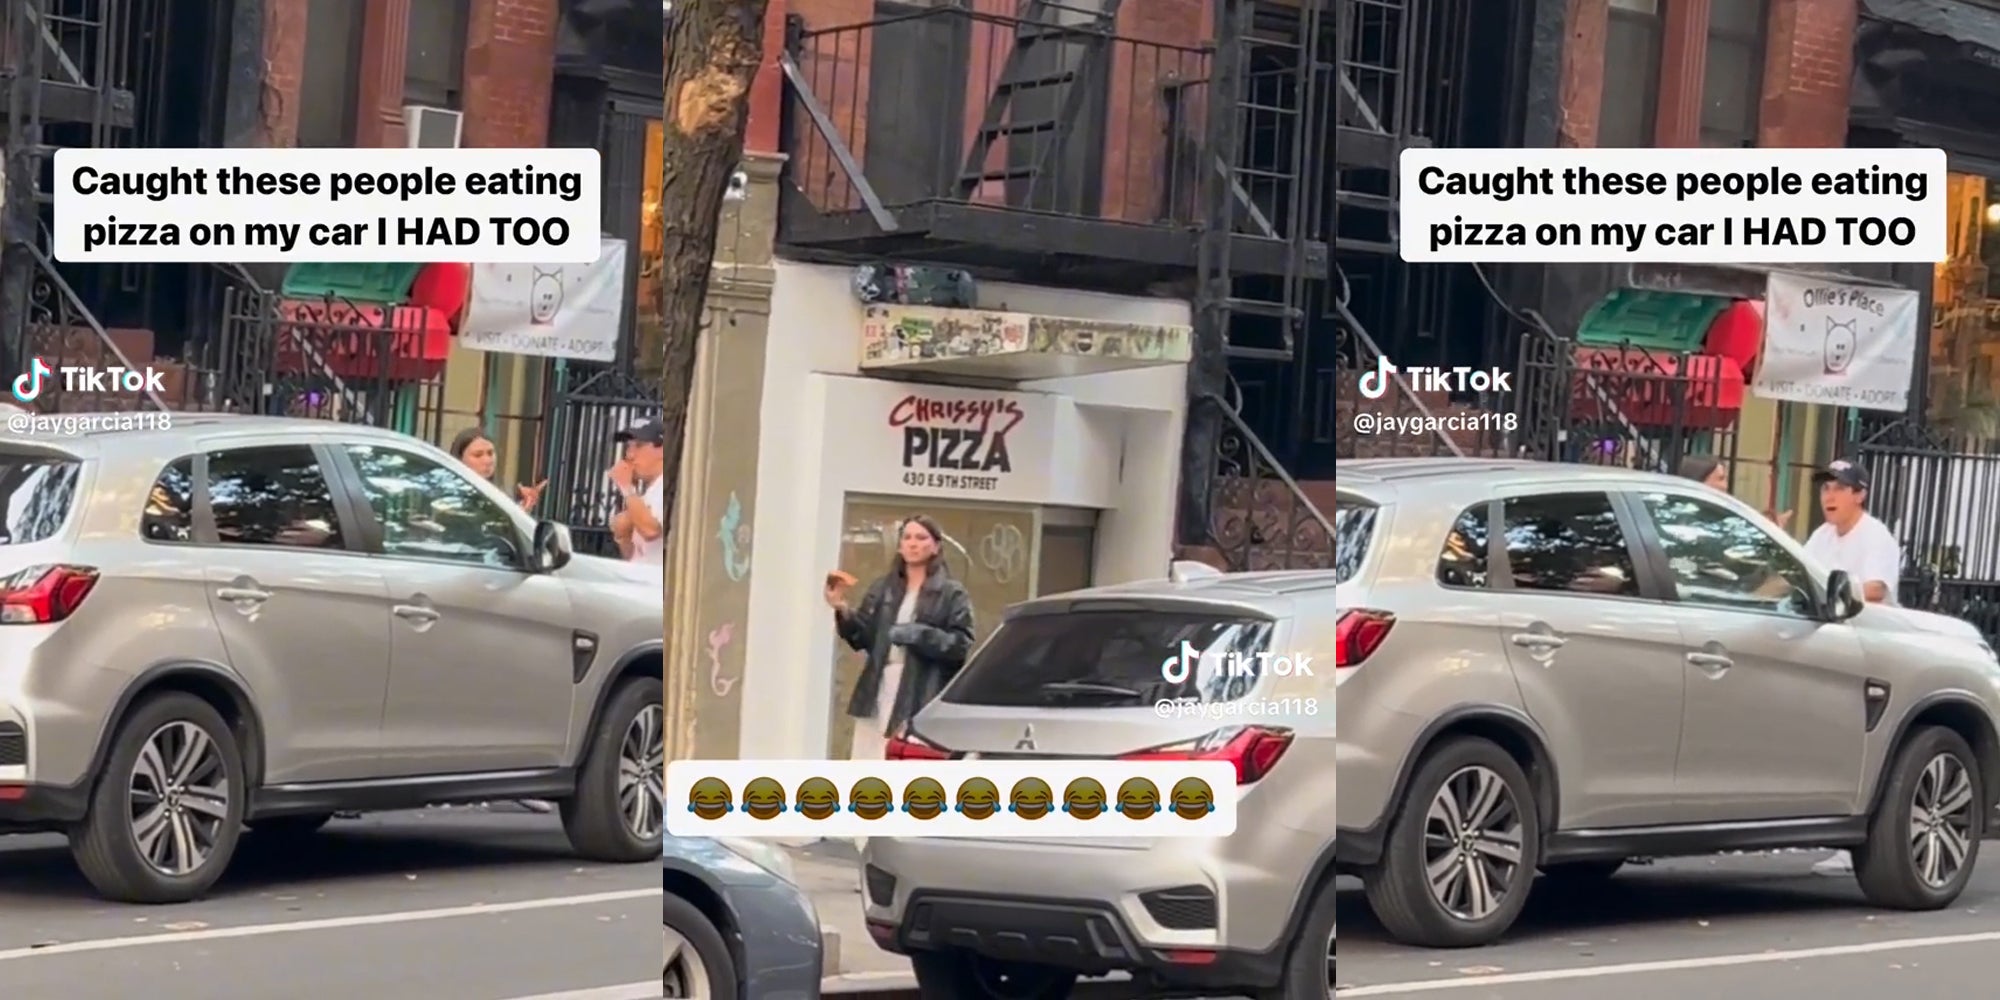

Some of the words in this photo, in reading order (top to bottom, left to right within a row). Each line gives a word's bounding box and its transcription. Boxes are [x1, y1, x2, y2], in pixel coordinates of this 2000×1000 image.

[1803, 286, 1847, 308] Ollie's
[1849, 289, 1885, 317] Place
[511, 334, 559, 350] DONATE
[1804, 384, 1852, 400] DONATE
[902, 425, 1011, 473] PIZZA
[902, 471, 925, 486] 430
[959, 475, 998, 491] STREET
